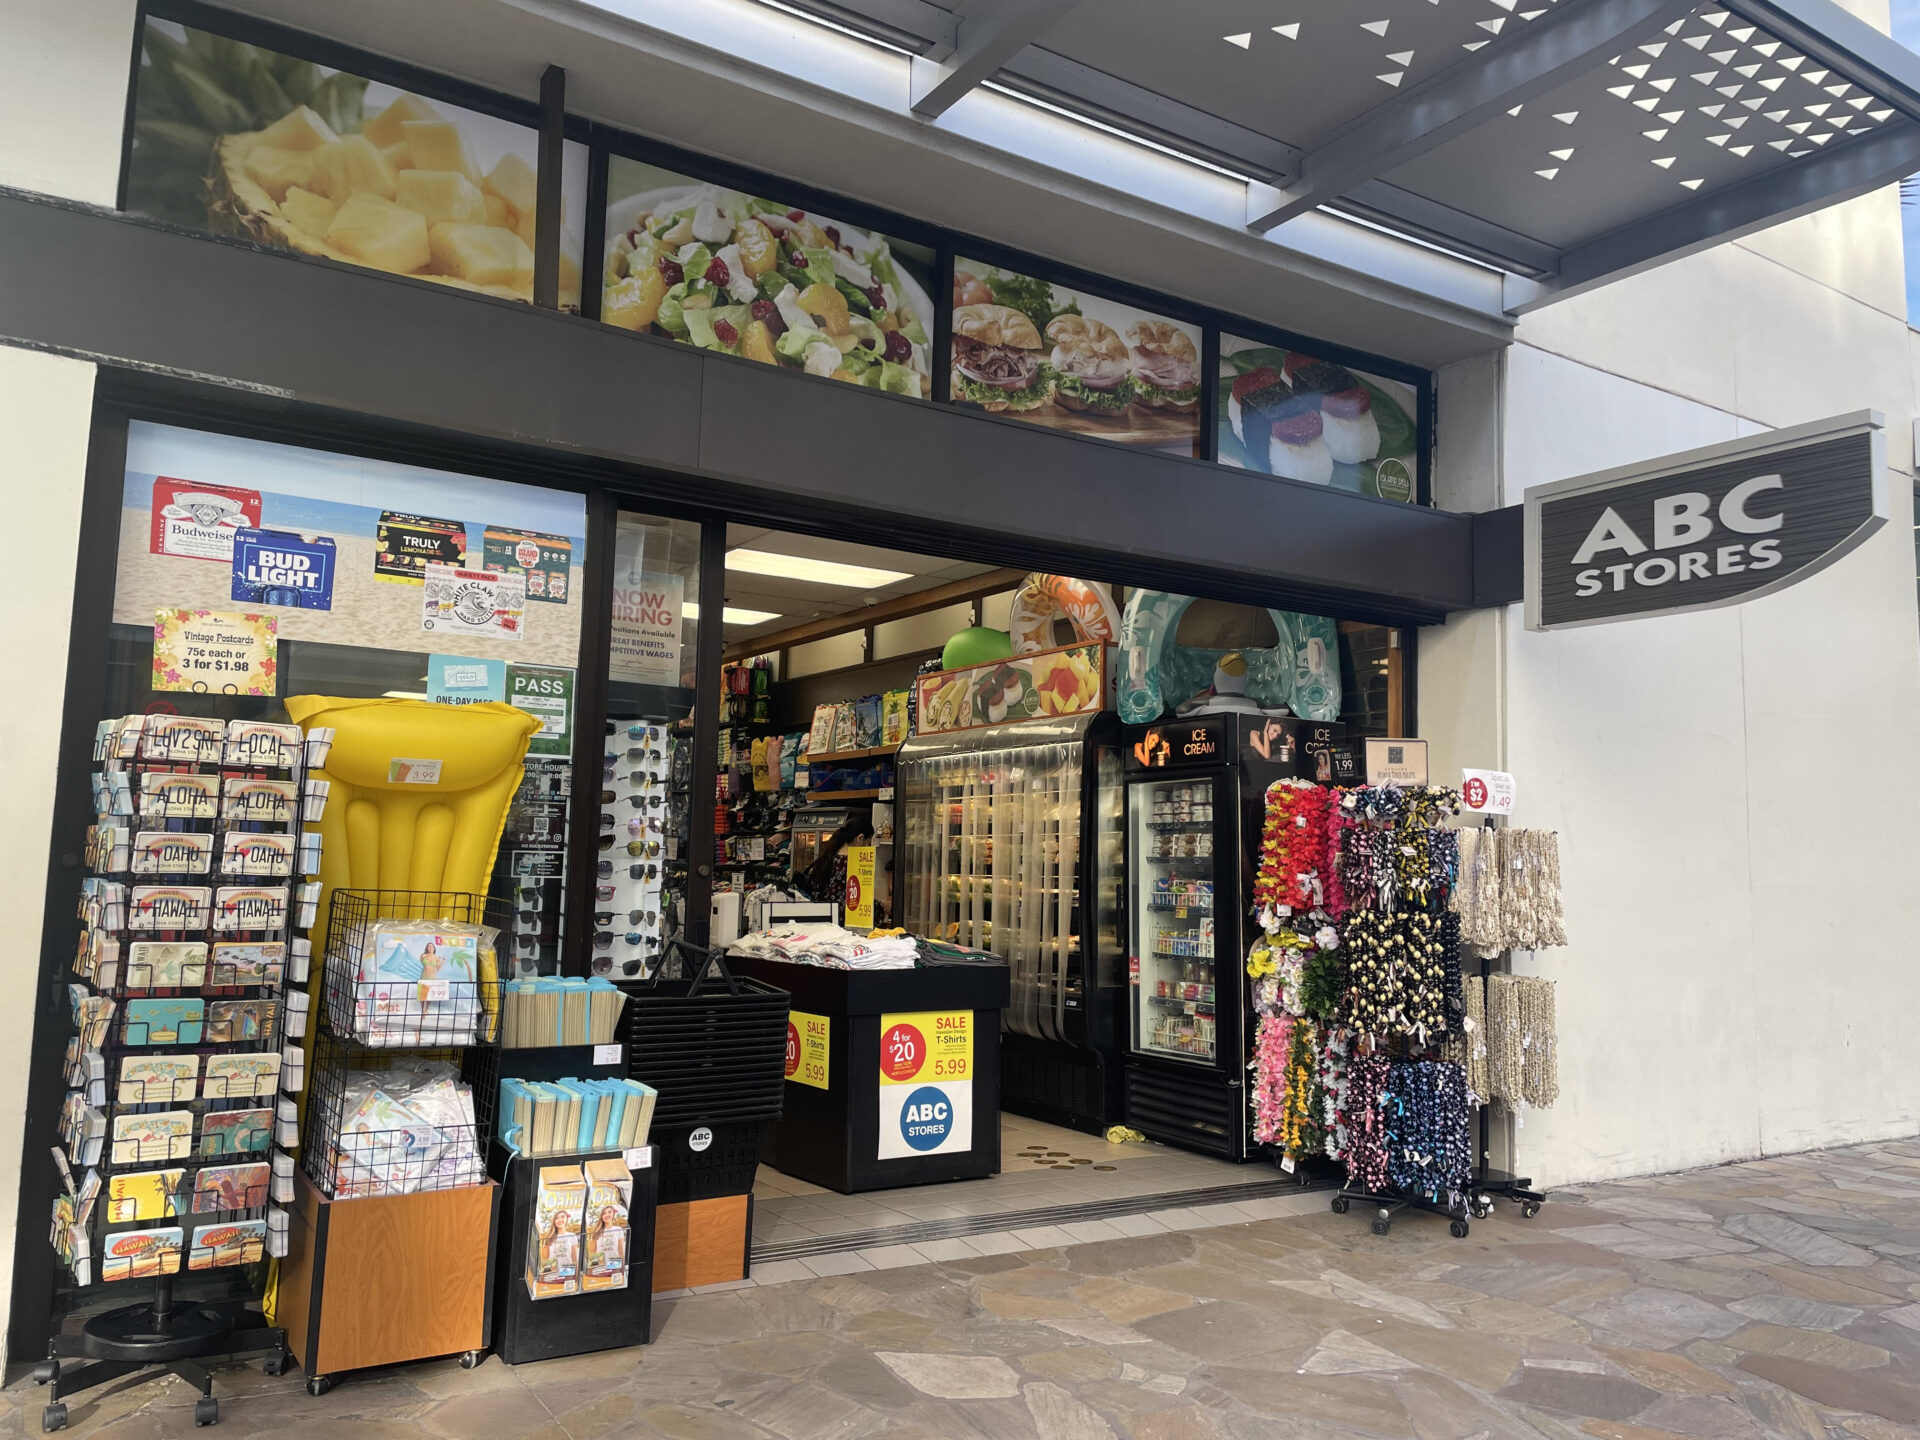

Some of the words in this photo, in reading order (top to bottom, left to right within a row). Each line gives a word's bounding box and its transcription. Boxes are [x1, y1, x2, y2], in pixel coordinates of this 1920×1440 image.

[1571, 474, 1783, 564] ABC
[172, 524, 233, 541] Budweise
[400, 546, 436, 555] LEMONADE
[403, 535, 440, 550] TRULY
[258, 550, 311, 571] BUD
[1575, 539, 1783, 597] STORES
[247, 565, 320, 588] LIGHT
[457, 571, 481, 580] VARIETY
[454, 583, 470, 607] WHITE
[470, 582, 495, 598] CLAW
[613, 588, 666, 609] NOW
[459, 611, 476, 623] HARD
[477, 603, 495, 623] SELTZER
[184, 631, 214, 643] Vintage
[216, 633, 254, 644] Postcards
[641, 629, 676, 639] Available
[632, 640, 665, 649] BENEFITS
[187, 647, 206, 657] 75¢
[208, 649, 233, 659] each
[235, 651, 246, 659] or
[610, 647, 645, 656] MPETITIVE
[646, 650, 674, 659] WAGES
[182, 658, 190, 669] 3
[194, 660, 212, 669] for
[215, 660, 249, 672] $1.98
[515, 677, 564, 695] PASS
[436, 695, 472, 705] ONE-DAY
[1191, 728, 1207, 742] ICE
[1314, 728, 1331, 742] ICE
[239, 732, 286, 756] LOCAL
[1183, 742, 1215, 756] CREAM
[1335, 759, 1353, 770] 1.99
[156, 786, 208, 805] ALOHA
[237, 791, 285, 810] ALOHA
[1470, 788, 1483, 802] $2
[143, 845, 151, 861] I
[163, 845, 200, 862] OAHU
[231, 844, 239, 862] I
[250, 847, 285, 864] OAHU
[859, 851, 873, 862] SALE
[134, 898, 142, 917] I
[152, 898, 200, 918] HAWAII
[220, 900, 227, 919] I
[237, 898, 282, 918] HAWAII
[859, 904, 871, 917] 5.99
[377, 1003, 400, 1012] Mat
[264, 1003, 276, 1036] HAWAII
[936, 1016, 966, 1030] SALE
[807, 1020, 825, 1036] SALE
[806, 1038, 825, 1051] T-Shirts
[892, 1030, 900, 1043] 4
[901, 1034, 911, 1042] for
[936, 1035, 967, 1044] T-Shirts
[889, 1041, 915, 1063] $20
[805, 1062, 825, 1081] 5.99
[935, 1058, 967, 1076] 5.99
[906, 1102, 948, 1123] ABC
[691, 1132, 710, 1142] ABC
[908, 1124, 945, 1137] STORES
[115, 1178, 125, 1221] HAWAII
[204, 1229, 240, 1246] HAWAII
[115, 1238, 152, 1255] HAWAII
